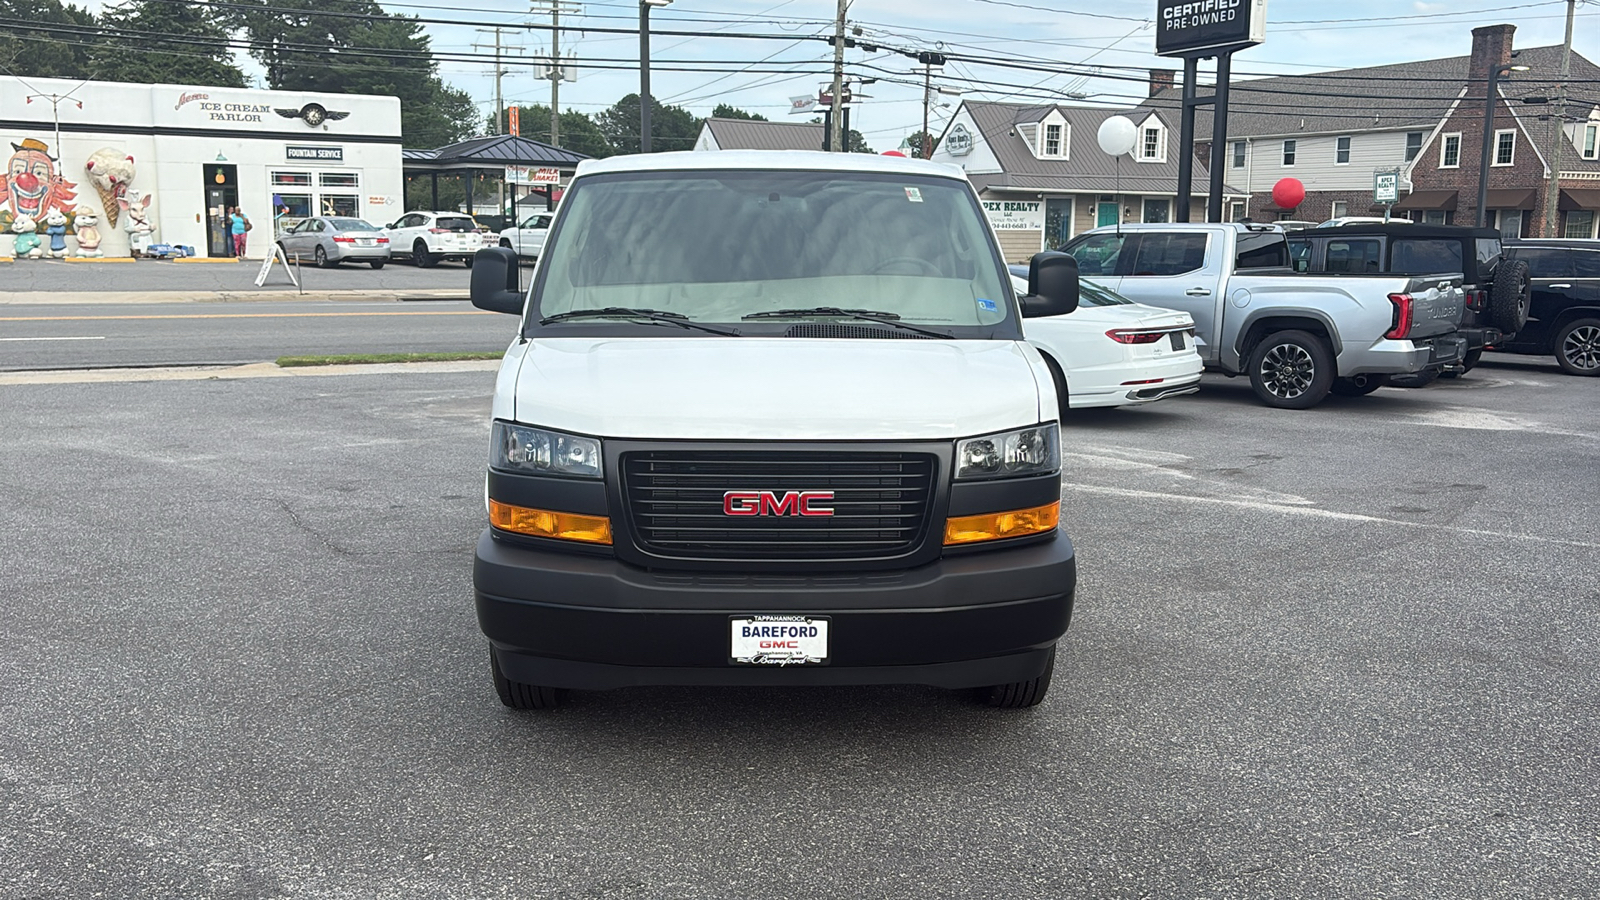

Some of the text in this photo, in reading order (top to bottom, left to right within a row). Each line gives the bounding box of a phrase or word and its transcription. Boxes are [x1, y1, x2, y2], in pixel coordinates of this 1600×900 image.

[1163, 0, 1240, 19] CERTIFIED
[1166, 9, 1235, 31] PRE-OWNED
[200, 102, 271, 113] ICE CREAM
[210, 113, 262, 122] PARLOR
[288, 148, 341, 159] FOUNTAIN SERVICE
[537, 167, 559, 175] MILK
[982, 202, 1040, 212] PEX REALTY
[723, 491, 835, 516] GMC
[742, 626, 818, 638] BAREFORD
[759, 640, 799, 649] GMC
[751, 654, 810, 668] Bareford
